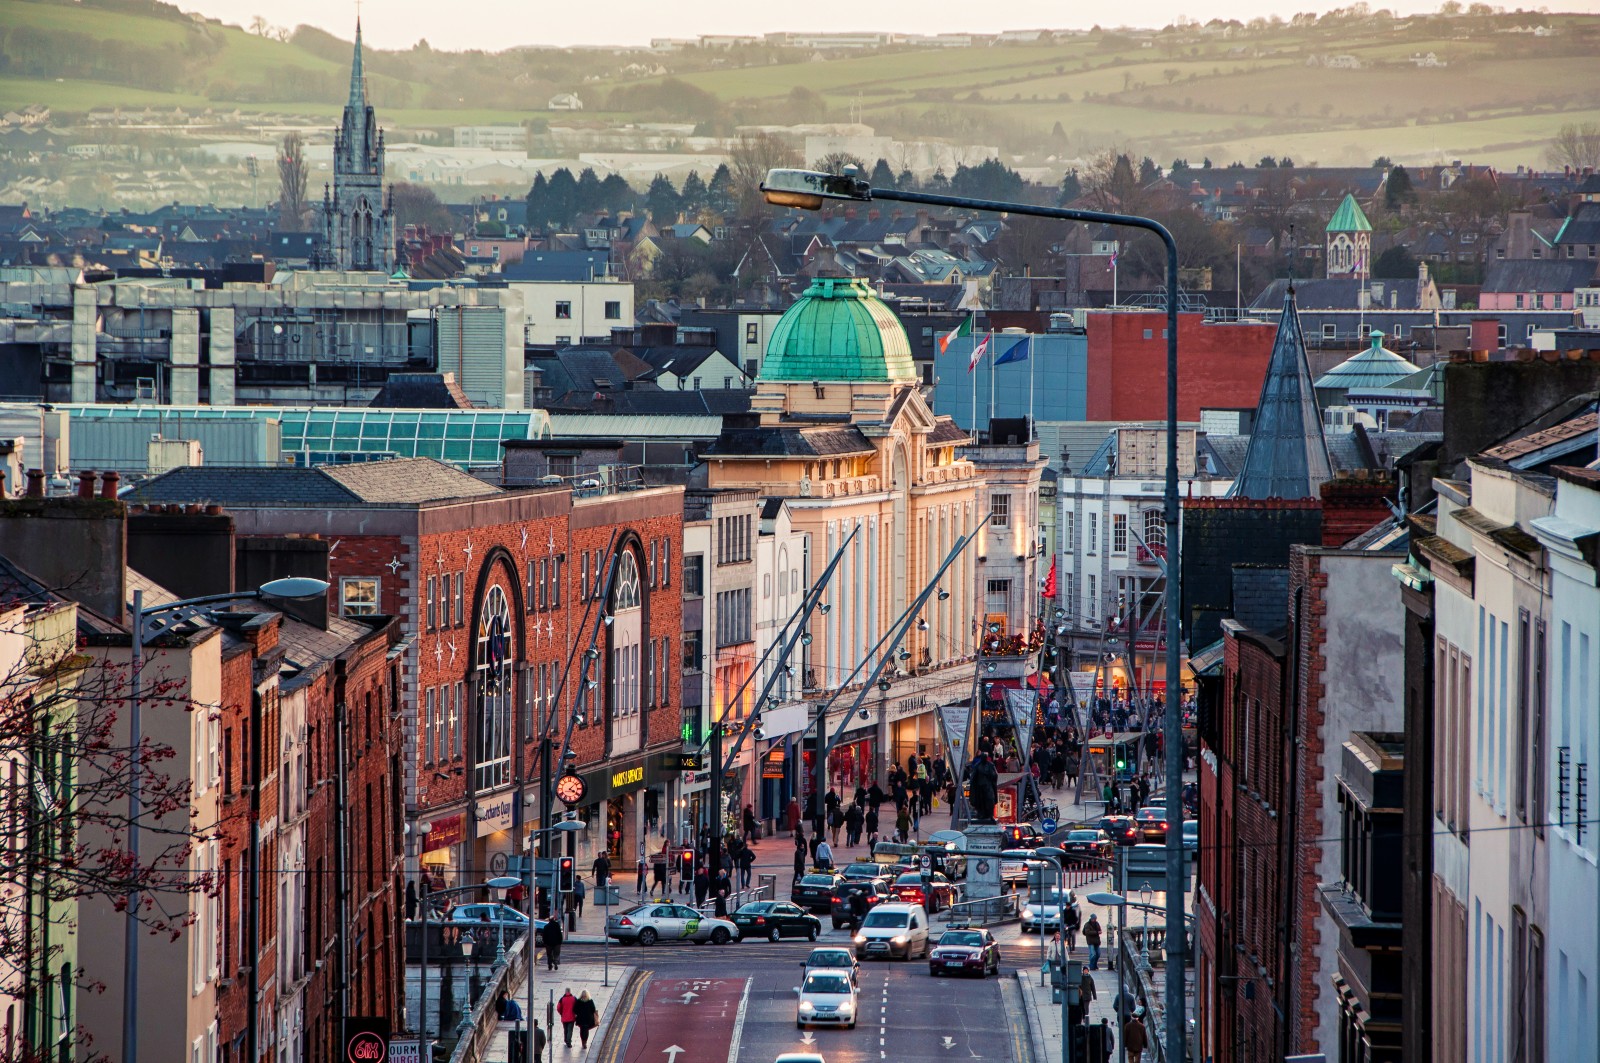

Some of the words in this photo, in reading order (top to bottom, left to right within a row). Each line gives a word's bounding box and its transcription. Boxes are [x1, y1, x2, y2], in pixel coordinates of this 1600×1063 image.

[898, 694, 927, 714] DEBENHAMS
[612, 771, 625, 788] MARKS
[627, 766, 643, 784] SPENCER
[481, 803, 500, 821] erchants
[501, 801, 510, 818] Quay
